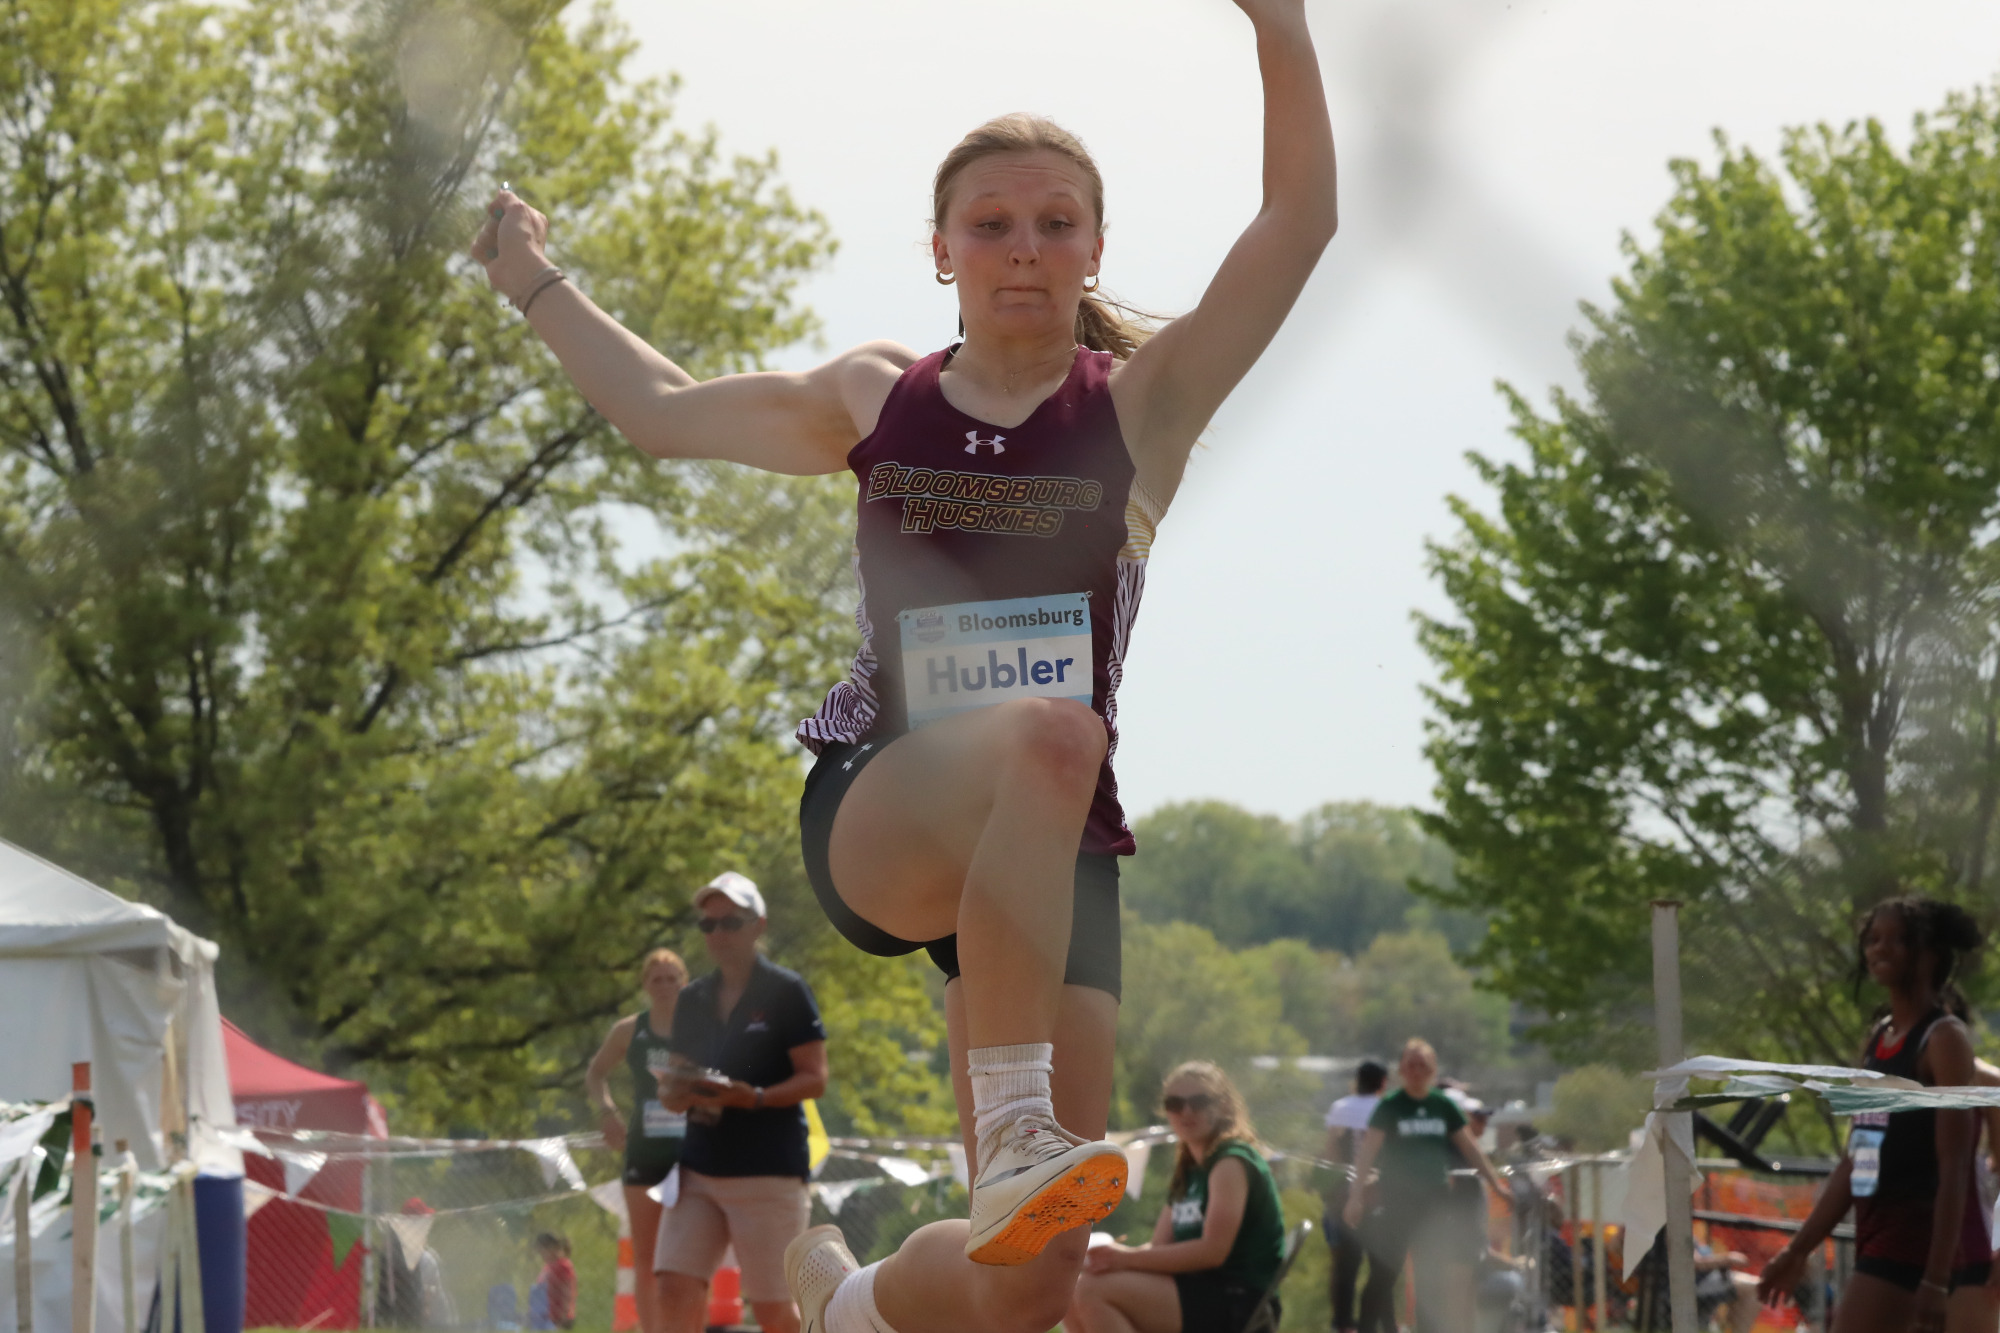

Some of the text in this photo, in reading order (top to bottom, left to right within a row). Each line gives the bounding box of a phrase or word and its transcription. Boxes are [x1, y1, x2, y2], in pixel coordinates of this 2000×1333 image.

[867, 462, 1102, 510] BLOOMSBURG
[902, 497, 1063, 537] HUSKIES
[958, 608, 1084, 633] Bloomsburg
[927, 647, 1074, 695] Hubler
